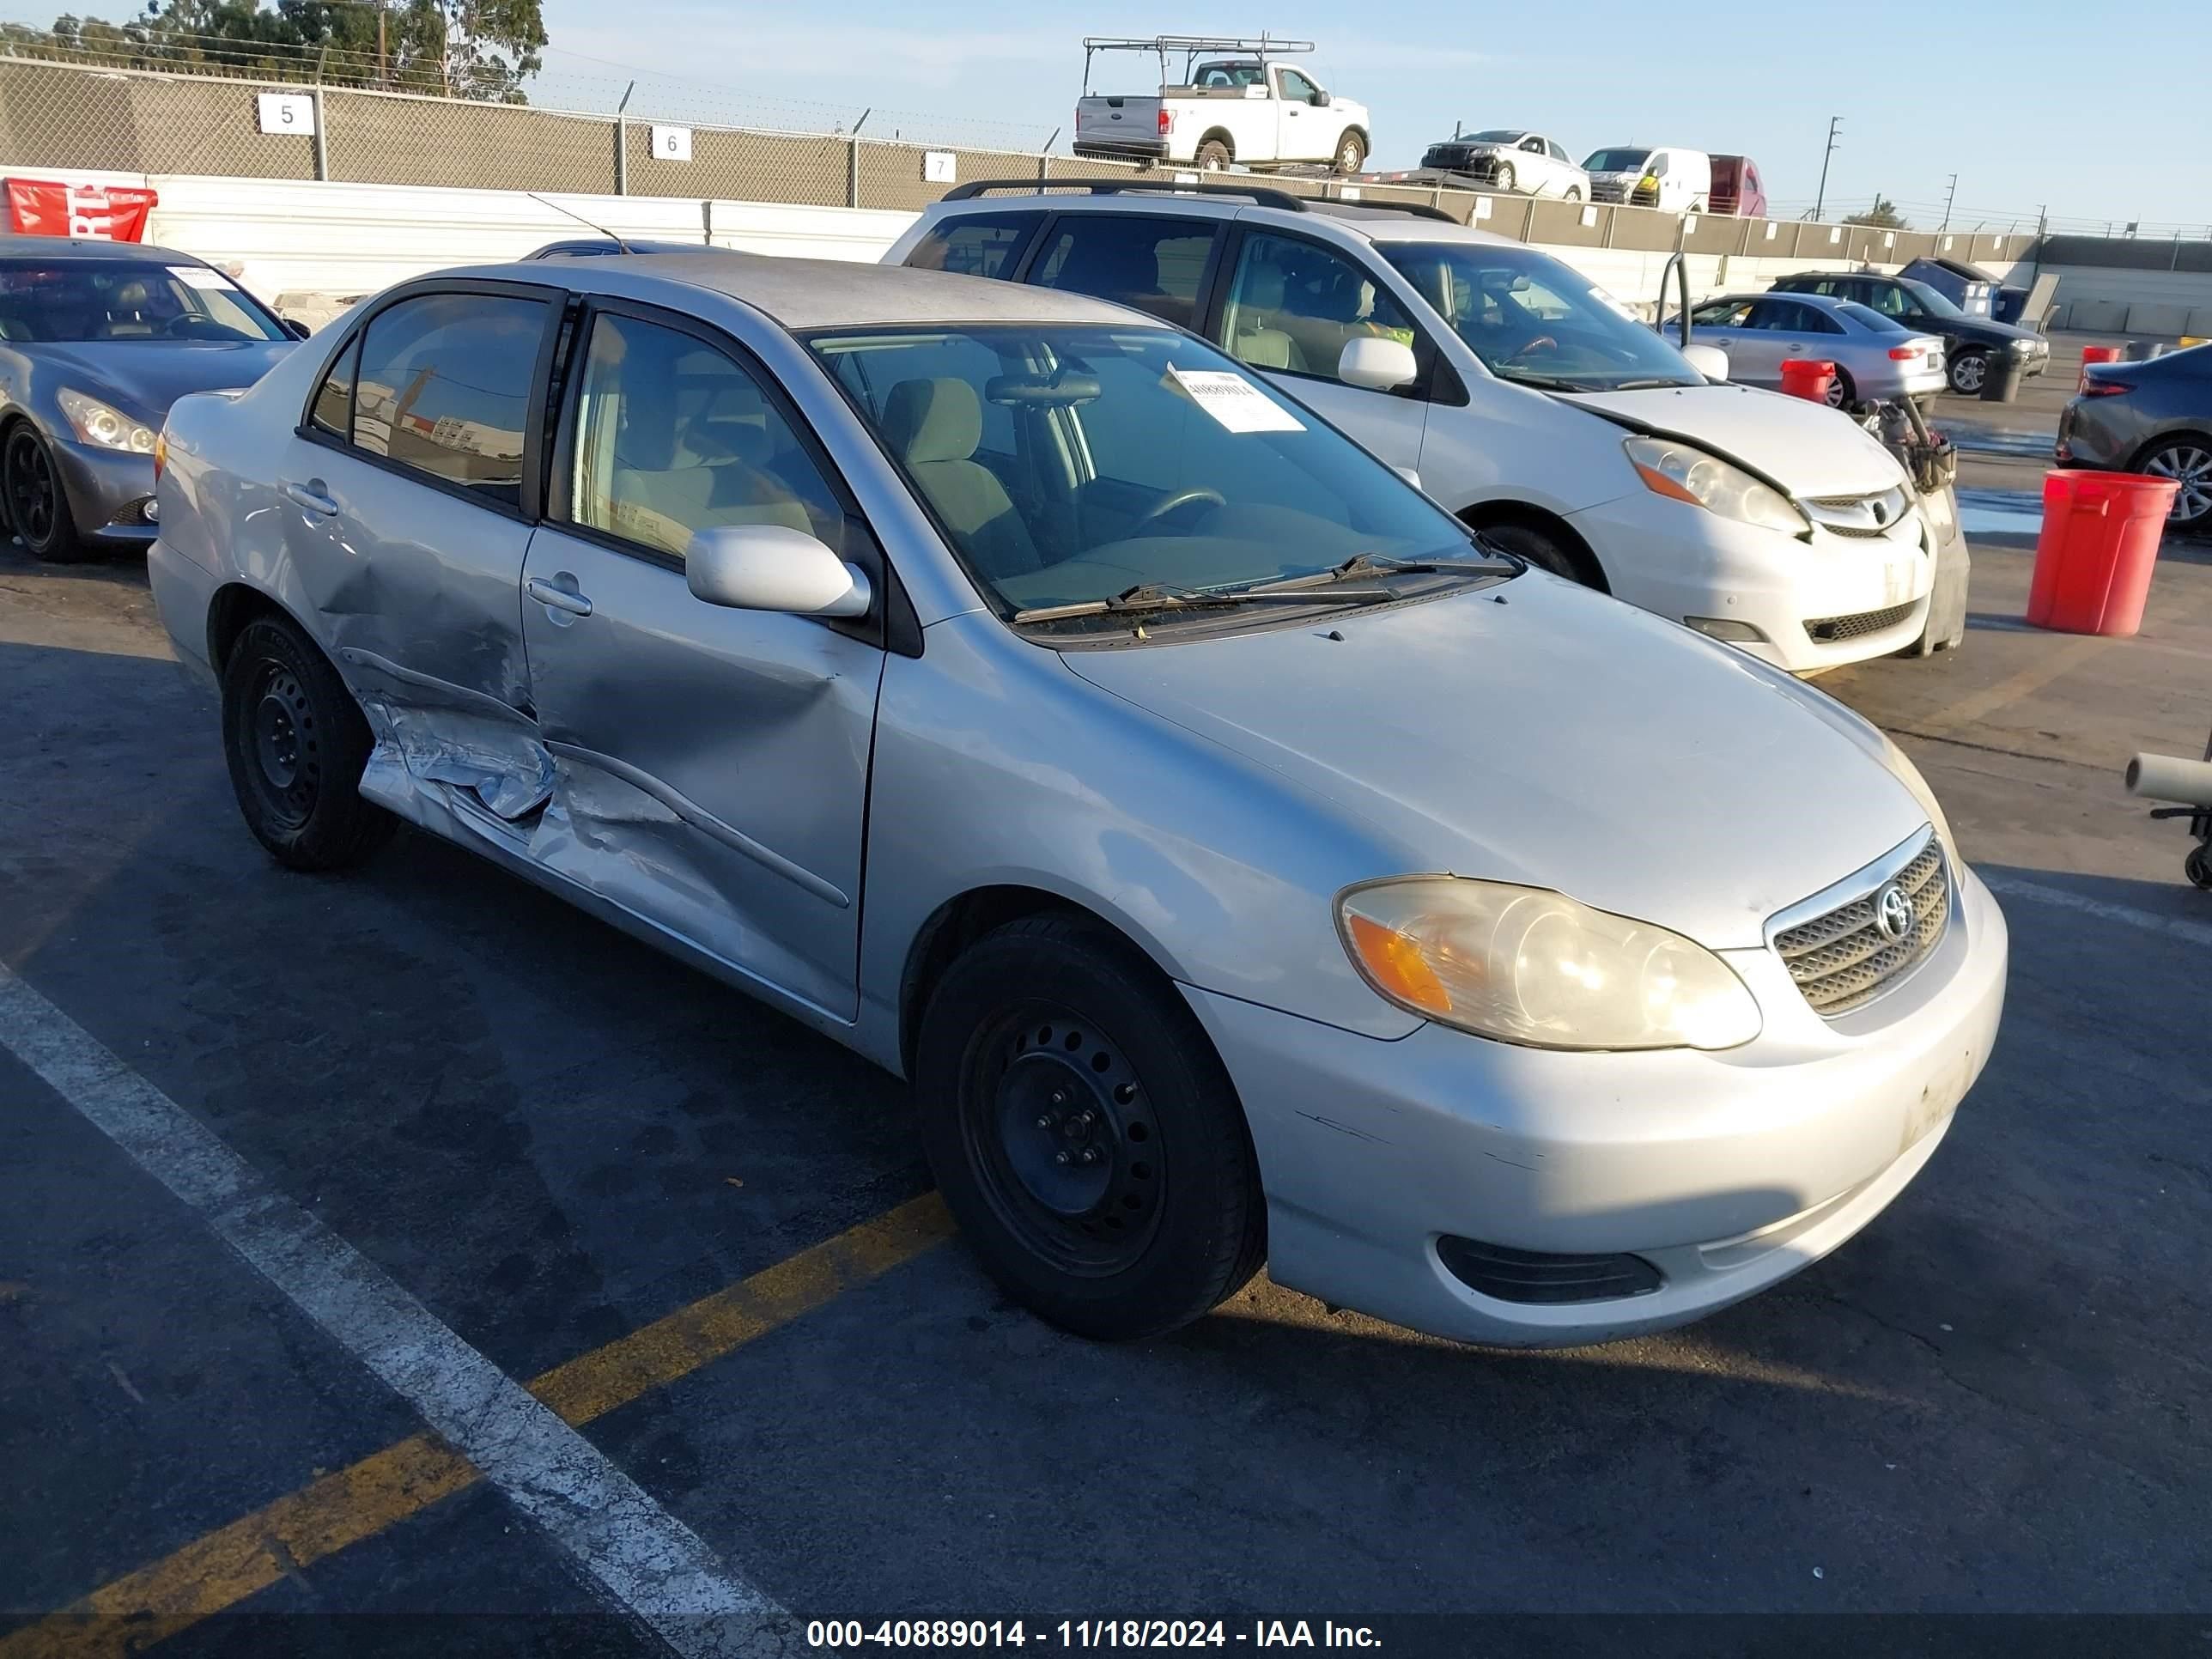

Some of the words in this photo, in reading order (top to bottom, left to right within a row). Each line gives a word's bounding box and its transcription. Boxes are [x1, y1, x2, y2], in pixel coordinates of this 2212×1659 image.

[281, 105, 294, 125] 5
[667, 135, 678, 152] 6
[936, 160, 945, 176] 7
[1188, 384, 1255, 396] 40889014
